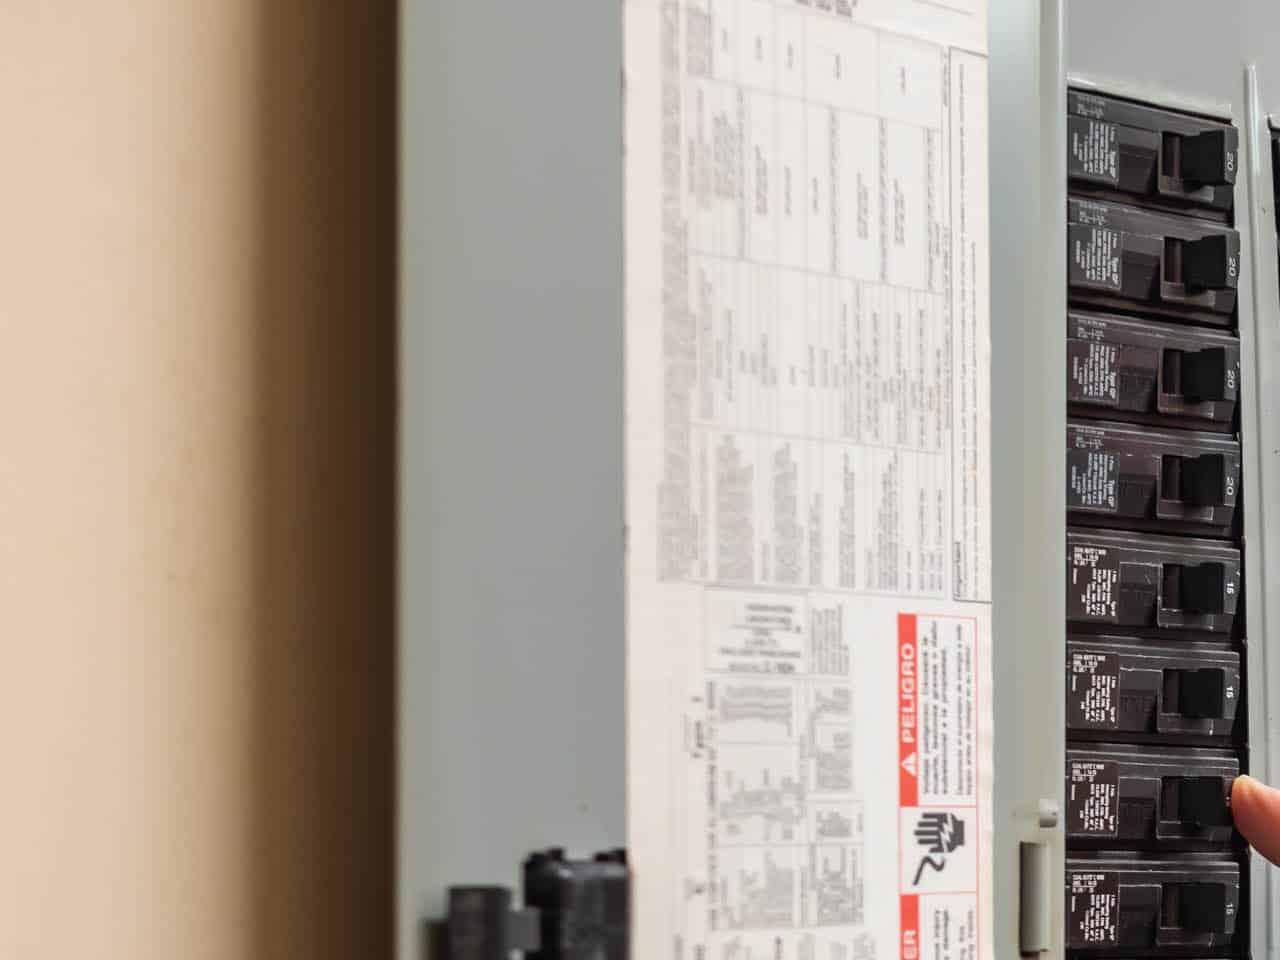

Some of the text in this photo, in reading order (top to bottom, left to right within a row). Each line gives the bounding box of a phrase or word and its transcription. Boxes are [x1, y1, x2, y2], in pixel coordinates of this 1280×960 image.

[1227, 152, 1234, 171] 20
[1229, 257, 1236, 276] 20
[1227, 369, 1235, 388] 20
[1227, 476, 1234, 495] 20
[1226, 581, 1234, 594] 15
[902, 643, 914, 743] PELIGRO
